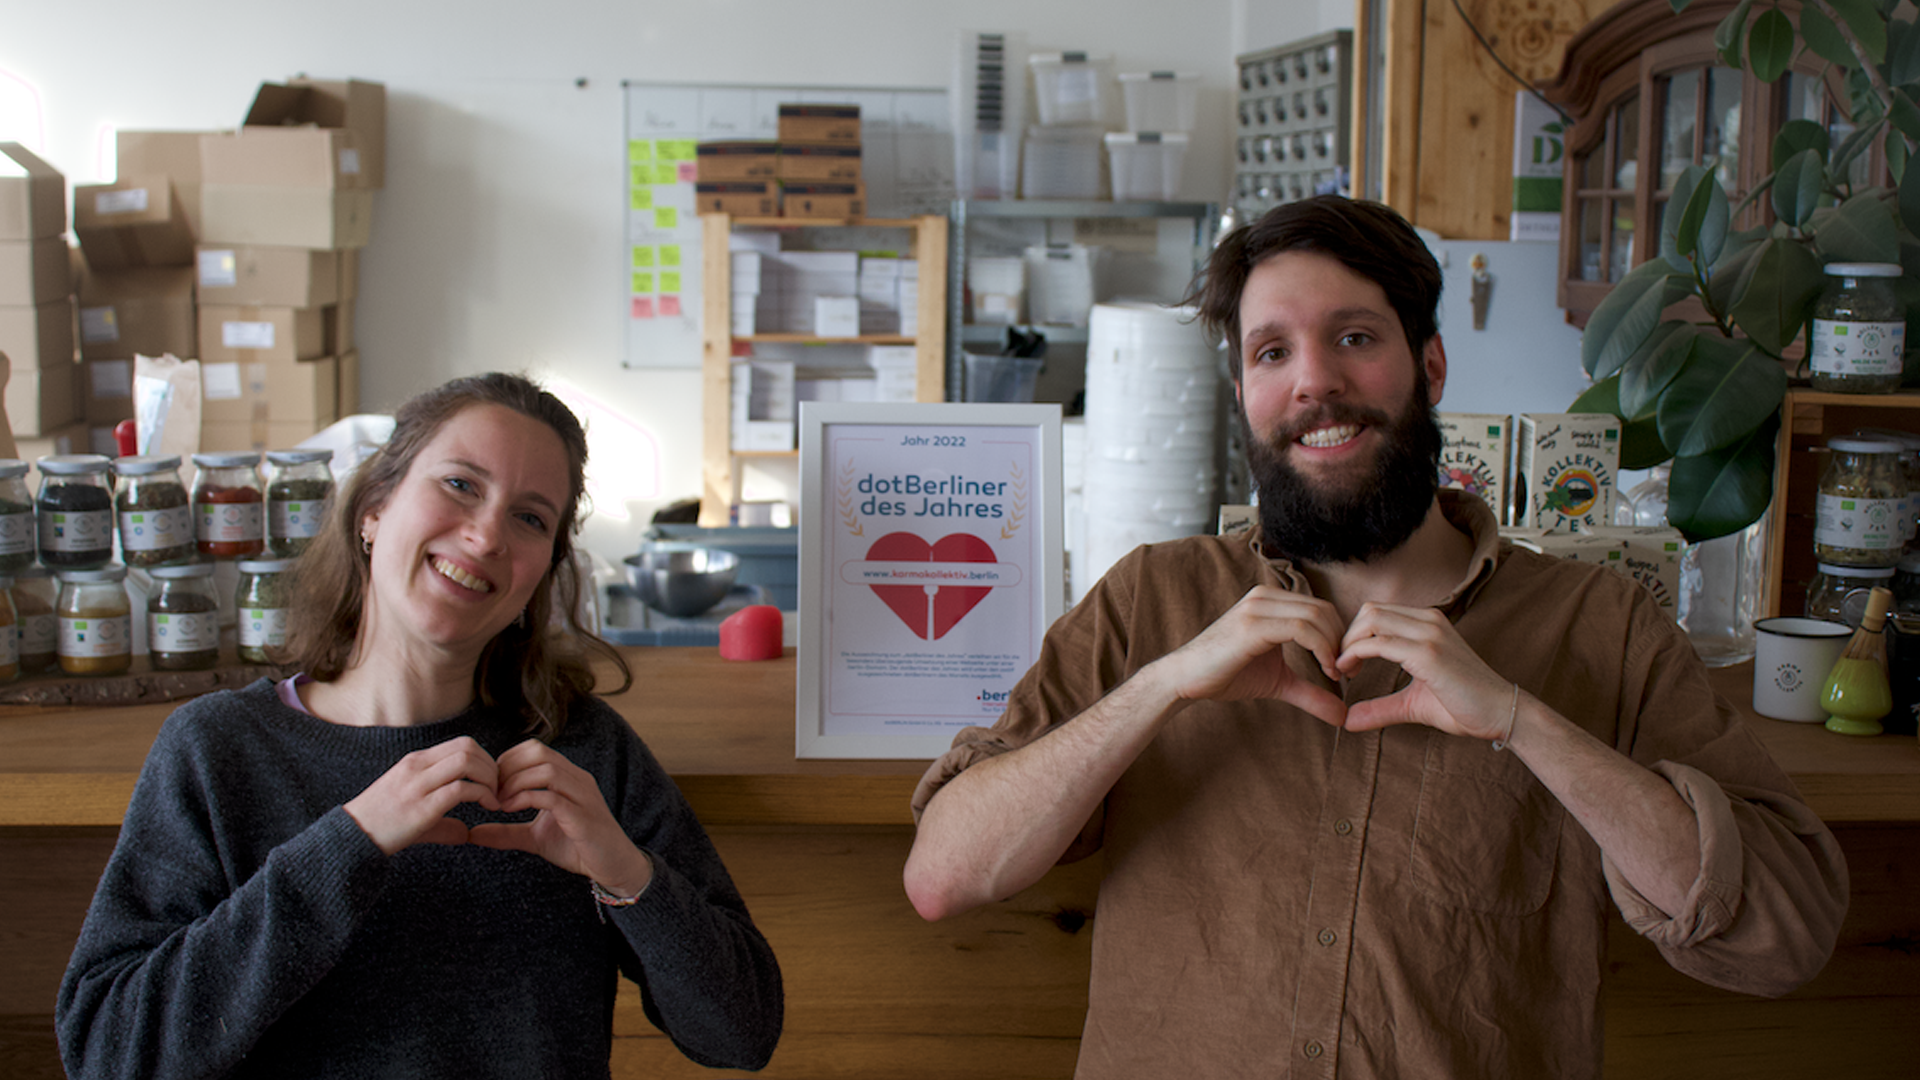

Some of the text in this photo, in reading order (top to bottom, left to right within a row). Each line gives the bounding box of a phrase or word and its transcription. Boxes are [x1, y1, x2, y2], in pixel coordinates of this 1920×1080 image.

[900, 435, 966, 447] Jahr 2022
[1445, 451, 1496, 487] LEKTIV
[1542, 453, 1612, 487] KOLLEKTIV
[858, 473, 1007, 496] dotBerliner
[860, 495, 1003, 519] des Jahres
[1555, 513, 1597, 533] TEE
[863, 569, 999, 581] www.karmakollektiv.berlin
